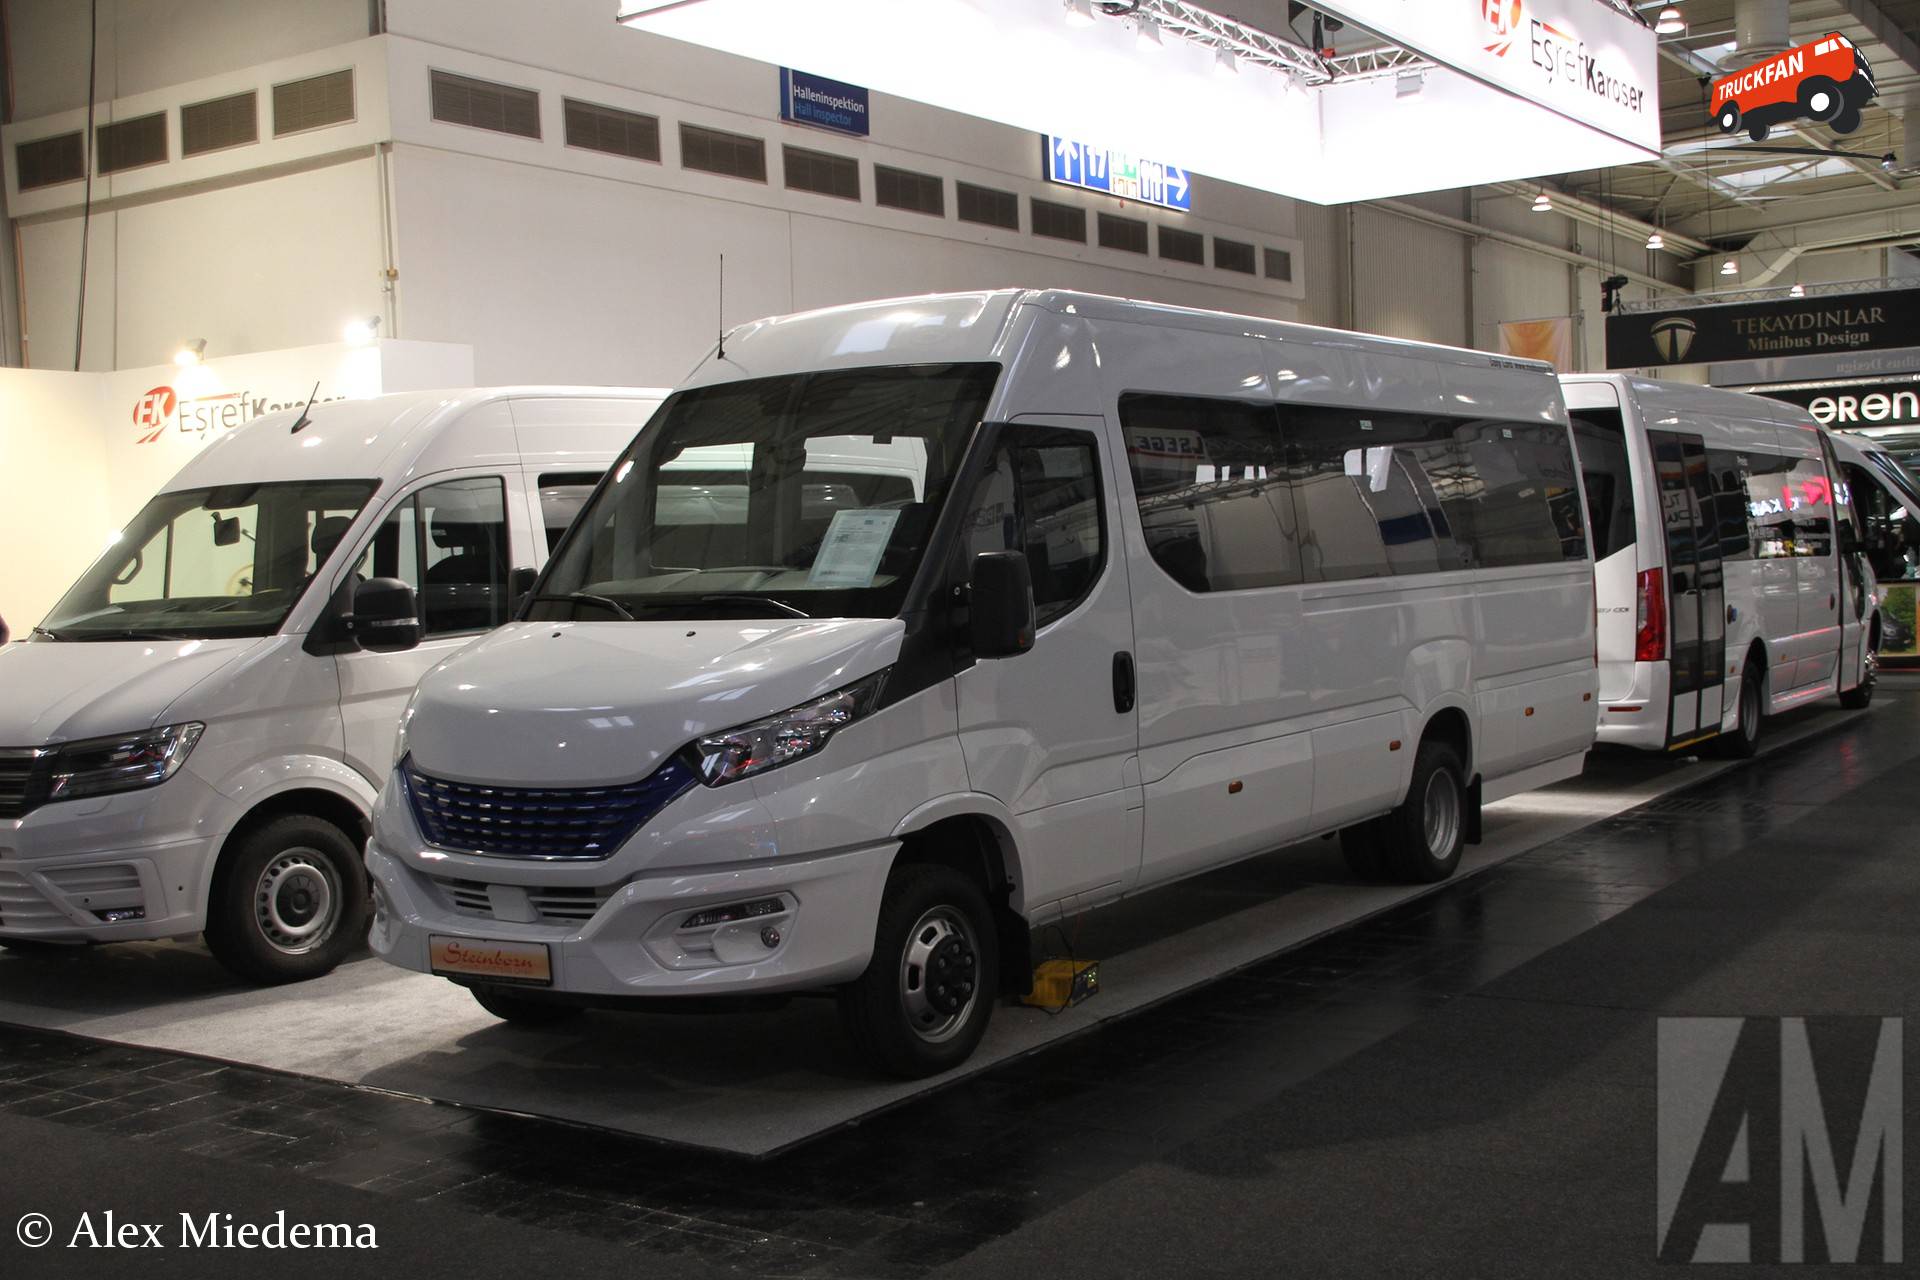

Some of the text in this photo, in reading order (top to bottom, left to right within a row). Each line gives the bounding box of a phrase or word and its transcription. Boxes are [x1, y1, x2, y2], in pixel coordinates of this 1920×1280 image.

[793, 84, 865, 114] Halleninspektion
[794, 102, 812, 117] Hall
[1731, 306, 1885, 336] TEKAYDINLAR
[1748, 330, 1870, 351] Minibus Design
[442, 941, 533, 968] Steinborn
